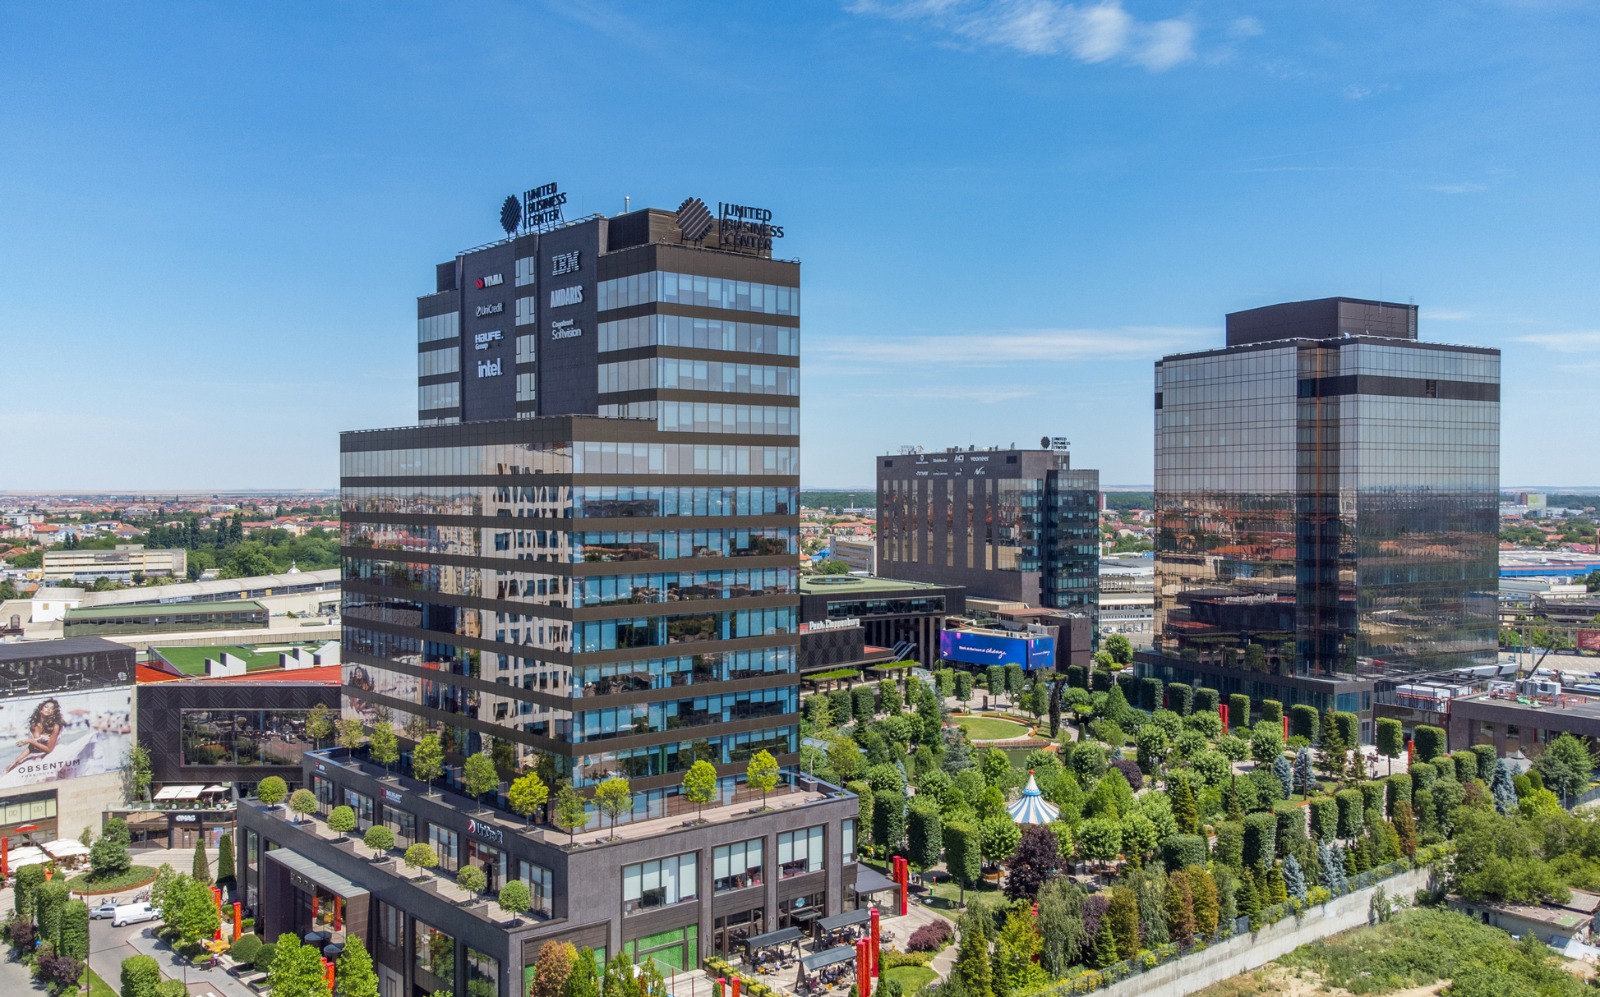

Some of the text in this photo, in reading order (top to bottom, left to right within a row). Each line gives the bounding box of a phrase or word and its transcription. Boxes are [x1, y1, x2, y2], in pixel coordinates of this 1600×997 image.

[528, 182, 558, 200] UNITED
[528, 192, 567, 214] BUSINESS
[529, 209, 560, 227] CENTER
[725, 203, 772, 222] UNITED
[725, 219, 784, 238] BUSINESS
[725, 232, 773, 250] CENTER
[552, 250, 580, 275] IBM
[552, 328, 582, 340] Softvision
[985, 647, 1007, 660] change
[18, 759, 80, 774] OBSENTUM
